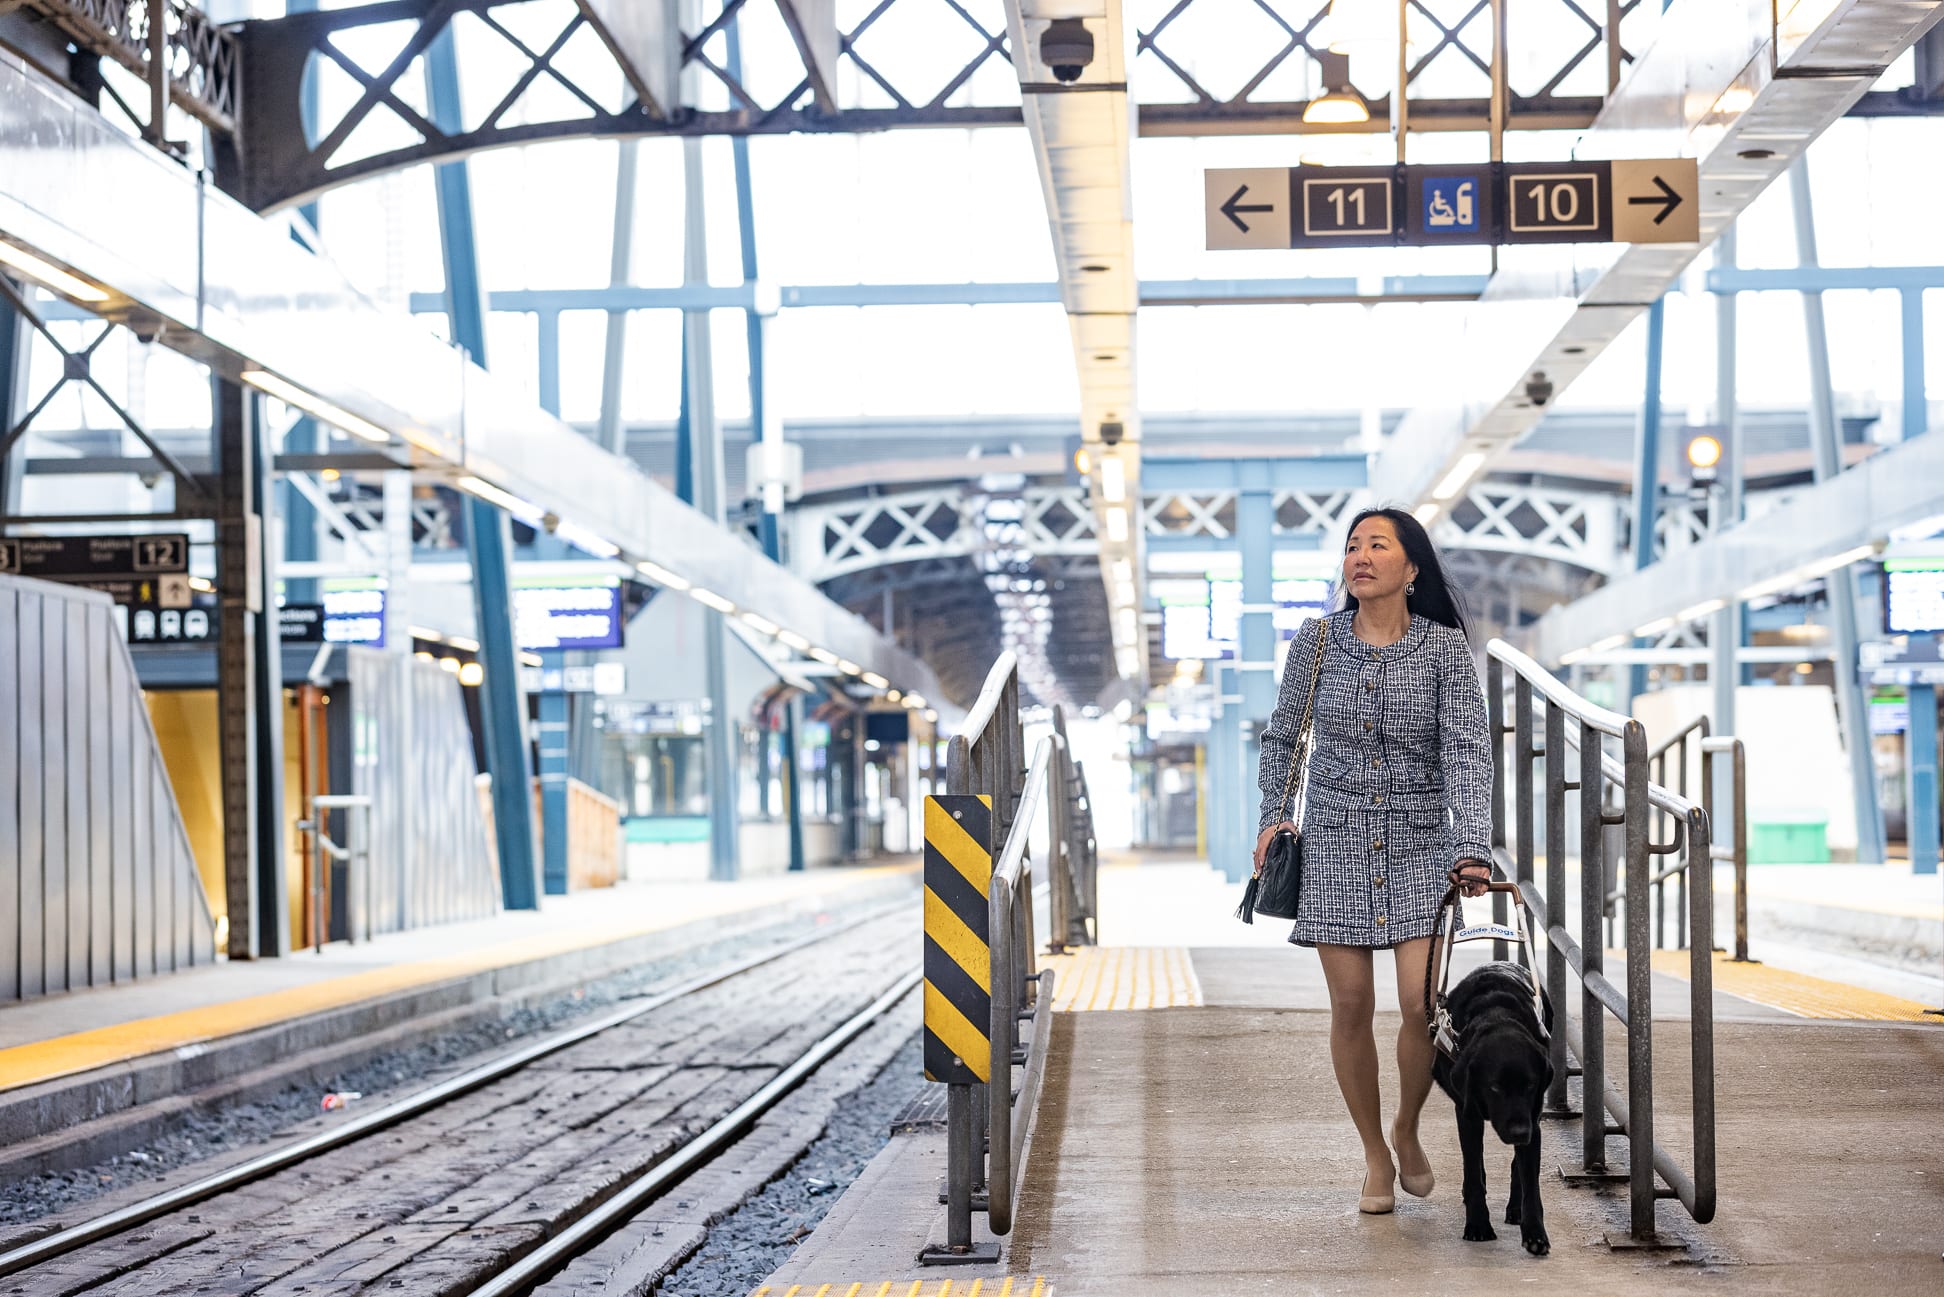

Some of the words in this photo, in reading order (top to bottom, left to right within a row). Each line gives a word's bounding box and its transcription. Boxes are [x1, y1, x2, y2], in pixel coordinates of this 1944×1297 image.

[1327, 188, 1367, 226] 11
[1528, 183, 1578, 222] 10
[144, 540, 174, 565] 12
[1460, 928, 1488, 936] Guide
[1491, 928, 1514, 936] Dogs
